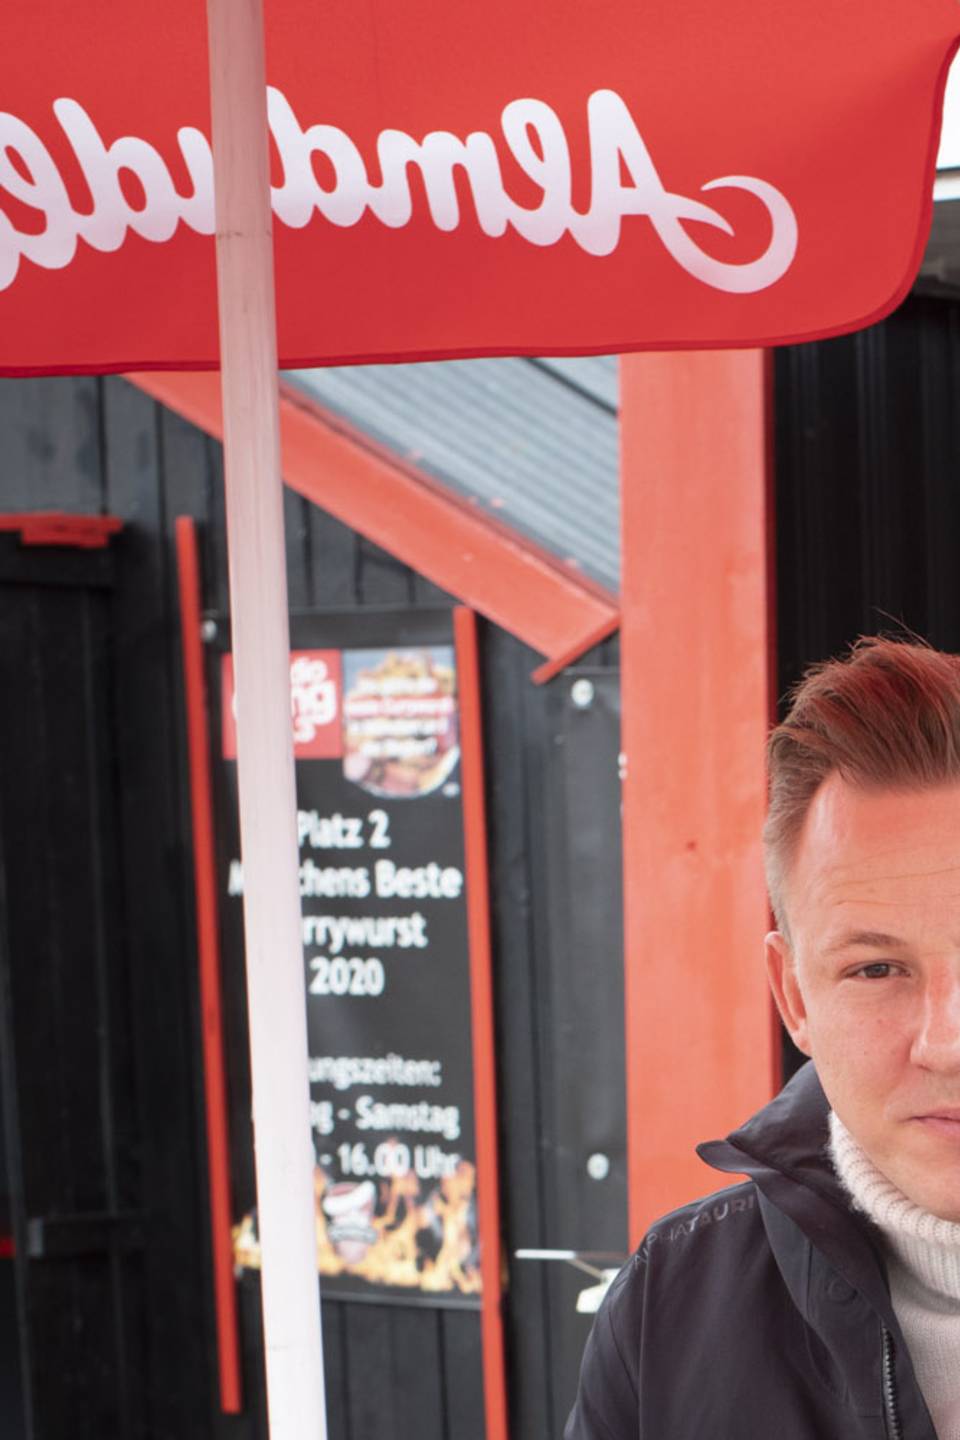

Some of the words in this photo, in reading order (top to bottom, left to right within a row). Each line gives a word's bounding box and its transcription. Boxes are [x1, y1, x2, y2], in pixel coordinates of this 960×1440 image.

[297, 810, 364, 848] Platz
[369, 809, 391, 849] 2
[228, 859, 370, 897] Mchens
[375, 859, 463, 898] Beste
[302, 912, 428, 953] rrywurst
[309, 957, 385, 995] 2020
[356, 1095, 460, 1140] Samstag
[338, 1142, 410, 1176] 16.00
[414, 1144, 460, 1178] Uhr
